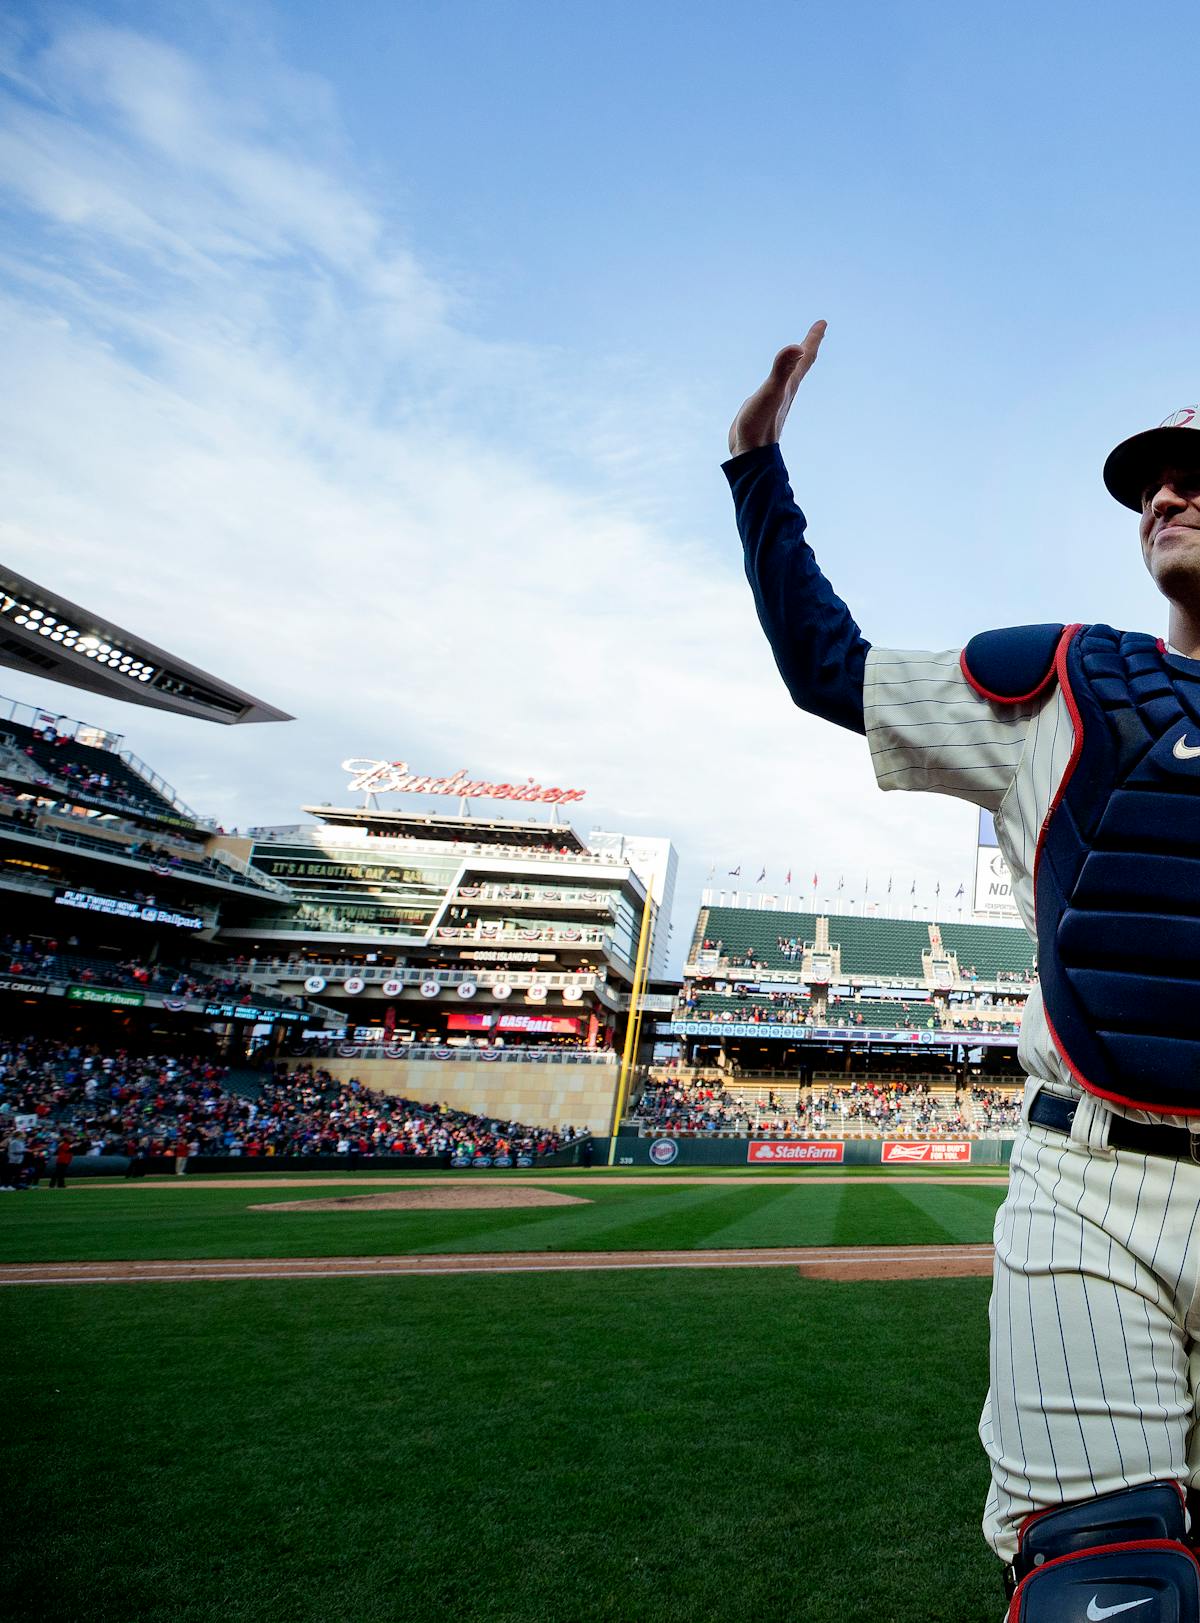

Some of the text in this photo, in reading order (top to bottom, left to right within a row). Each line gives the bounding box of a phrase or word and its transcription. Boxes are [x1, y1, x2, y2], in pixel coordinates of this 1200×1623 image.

[341, 758, 586, 804] Budweiser
[297, 864, 305, 875] A
[307, 864, 365, 878] BEAUTIFUL
[366, 866, 384, 880] DAY
[156, 911, 203, 929] Ballpark
[474, 951, 540, 963] GOOSE ISLAND PUB
[11, 982, 47, 993] CREAM
[499, 1015, 530, 1028] BASE
